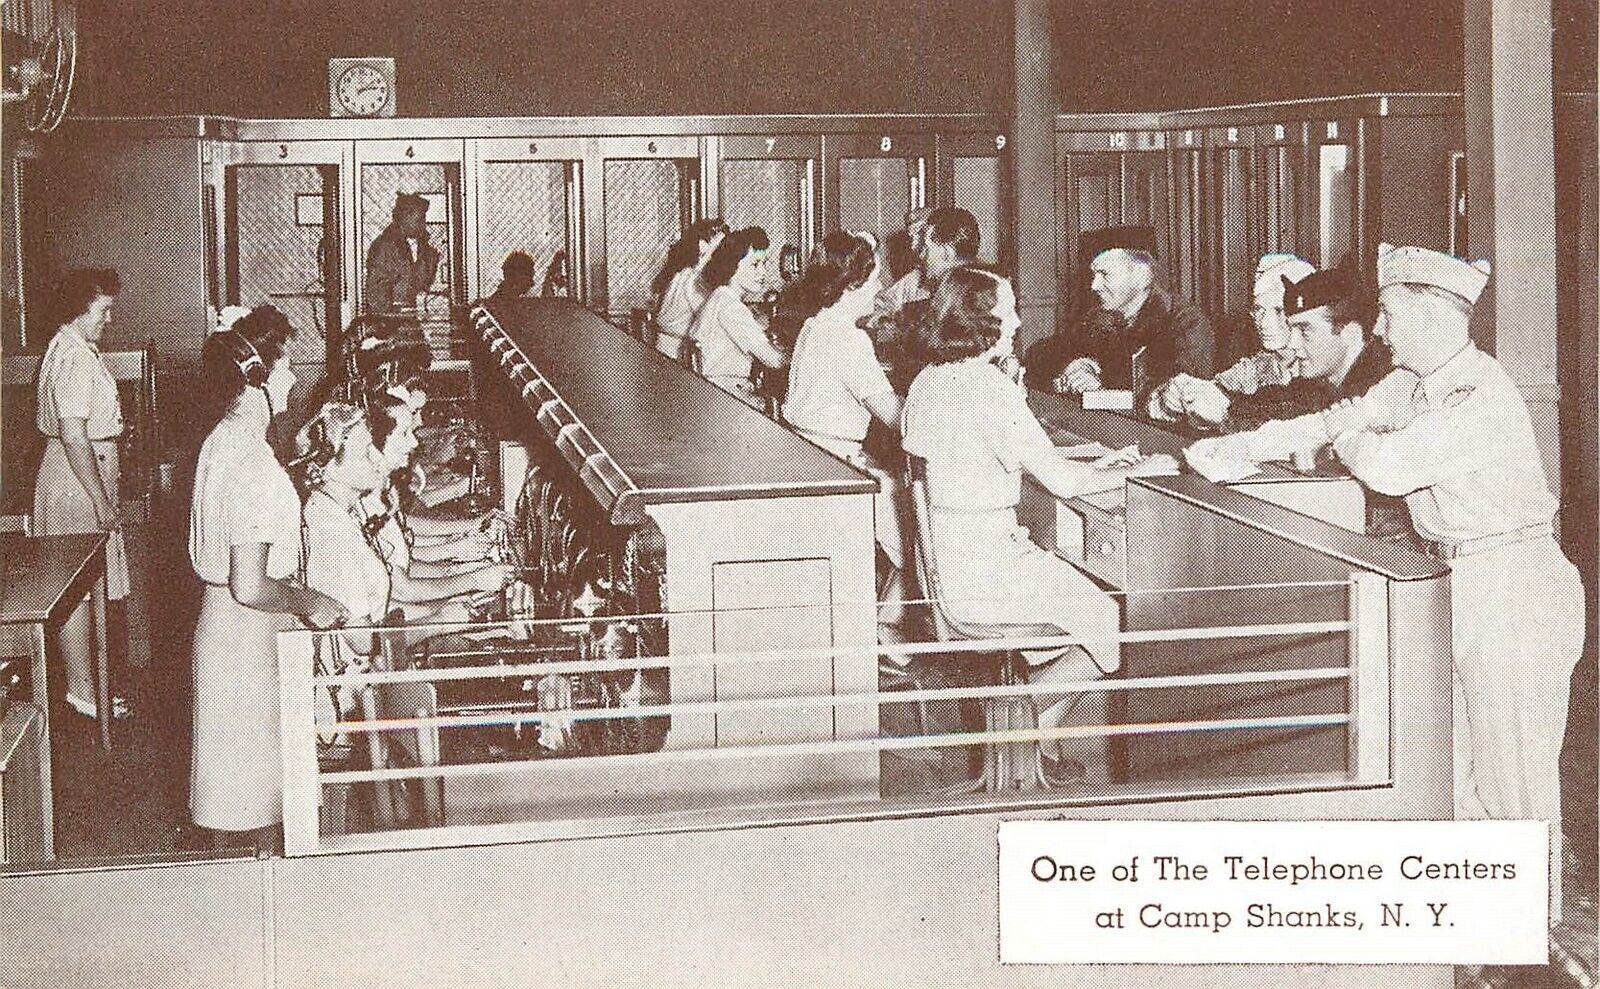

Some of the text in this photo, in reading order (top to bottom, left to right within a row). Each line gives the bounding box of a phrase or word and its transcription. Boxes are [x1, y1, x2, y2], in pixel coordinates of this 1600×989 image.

[647, 141, 658, 153] 6
[765, 138, 776, 154] 7
[880, 136, 891, 152] 8
[995, 134, 1006, 150] 9
[1109, 132, 1125, 148] 10
[278, 144, 289, 159] 3
[404, 145, 415, 159] 4
[528, 143, 538, 155] 5
